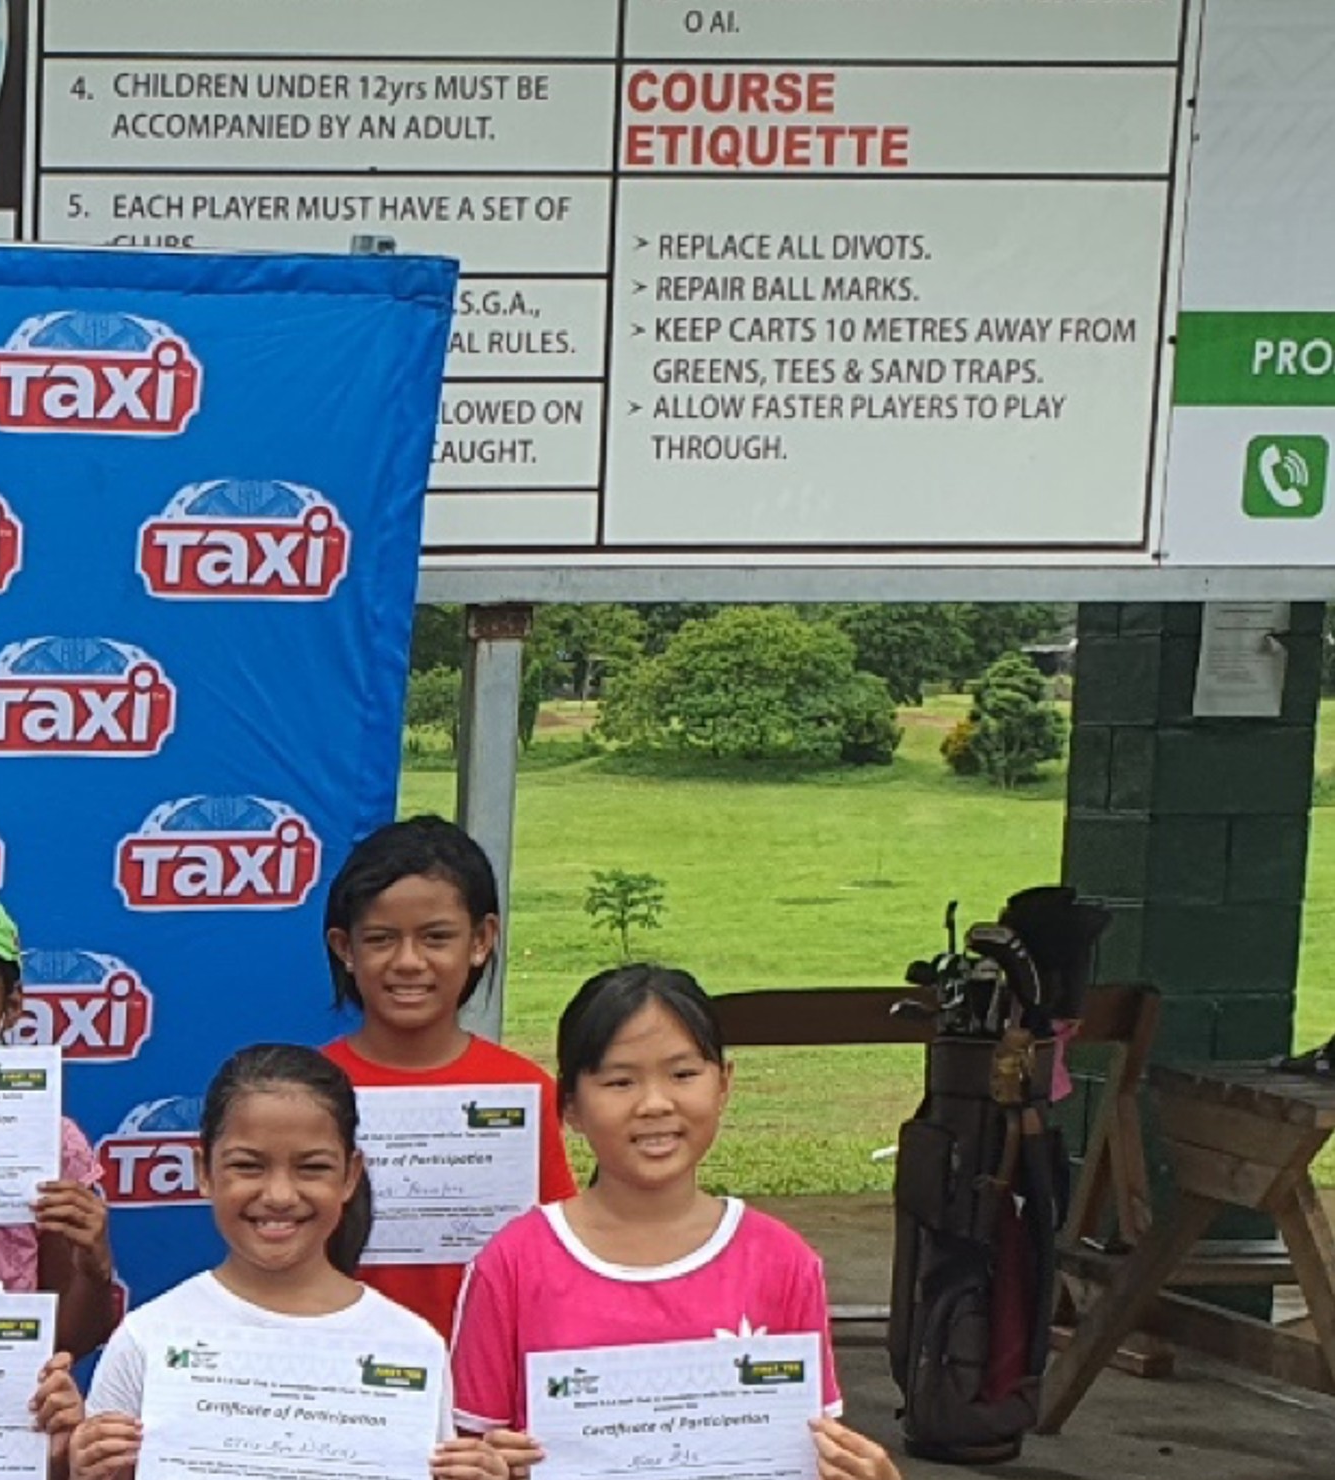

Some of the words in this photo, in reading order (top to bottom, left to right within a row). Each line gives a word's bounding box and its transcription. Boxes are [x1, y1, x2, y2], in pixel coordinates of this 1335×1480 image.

[70, 76, 93, 100] 4.
[113, 73, 248, 98] CHILDREN
[257, 74, 349, 99] UNDER
[360, 75, 427, 106] 12yrs
[435, 76, 510, 100] MUST
[518, 76, 548, 100] BE
[627, 72, 835, 113] COURSE
[112, 113, 311, 138] ACCOMPANIED
[319, 114, 350, 138] BY
[359, 115, 395, 138] AN
[403, 115, 494, 140] ADULT.
[626, 125, 909, 167] ETIQUETTE
[68, 194, 89, 218] 5.
[113, 194, 183, 219] EACH
[193, 196, 289, 220] PLAYER
[297, 196, 373, 221] MUST
[380, 196, 449, 221] HAVE
[457, 197, 474, 220] A
[483, 197, 530, 221] SET
[535, 197, 571, 221] OF
[660, 234, 771, 259] REPLACE
[777, 235, 825, 260] ALL
[833, 235, 931, 260] DIVOTS.
[656, 276, 745, 301] REPAIR
[753, 276, 815, 301] BALL
[822, 276, 919, 301] MARKS.
[452, 290, 540, 318] .S.G.A.,
[448, 330, 480, 354] AL
[488, 330, 575, 353] RULES.
[656, 317, 721, 342] KEEP
[729, 317, 816, 342] CARTS
[827, 318, 855, 342] 10
[864, 318, 967, 342] METRES
[975, 318, 1052, 342] AWAY
[1060, 318, 1136, 342] FROM
[1252, 338, 1335, 375] PRO
[653, 359, 766, 386] GREENS,
[773, 359, 835, 383] TEES
[843, 359, 863, 383] &
[870, 359, 946, 383] SAND
[952, 359, 1043, 383] TRAPS.
[437, 399, 536, 424] LOWED
[543, 400, 582, 424] ON
[653, 394, 745, 419] ALLOW
[752, 394, 843, 419] FASTER
[851, 394, 957, 419] PLAYERS
[964, 395, 997, 419] TO
[1004, 395, 1066, 419] PLAY
[652, 435, 787, 459] THROUGH.
[154, 514, 329, 587] Taxi
[131, 826, 298, 898] Taxi
[5, 979, 128, 1048] axi
[108, 1149, 194, 1193] Ta
